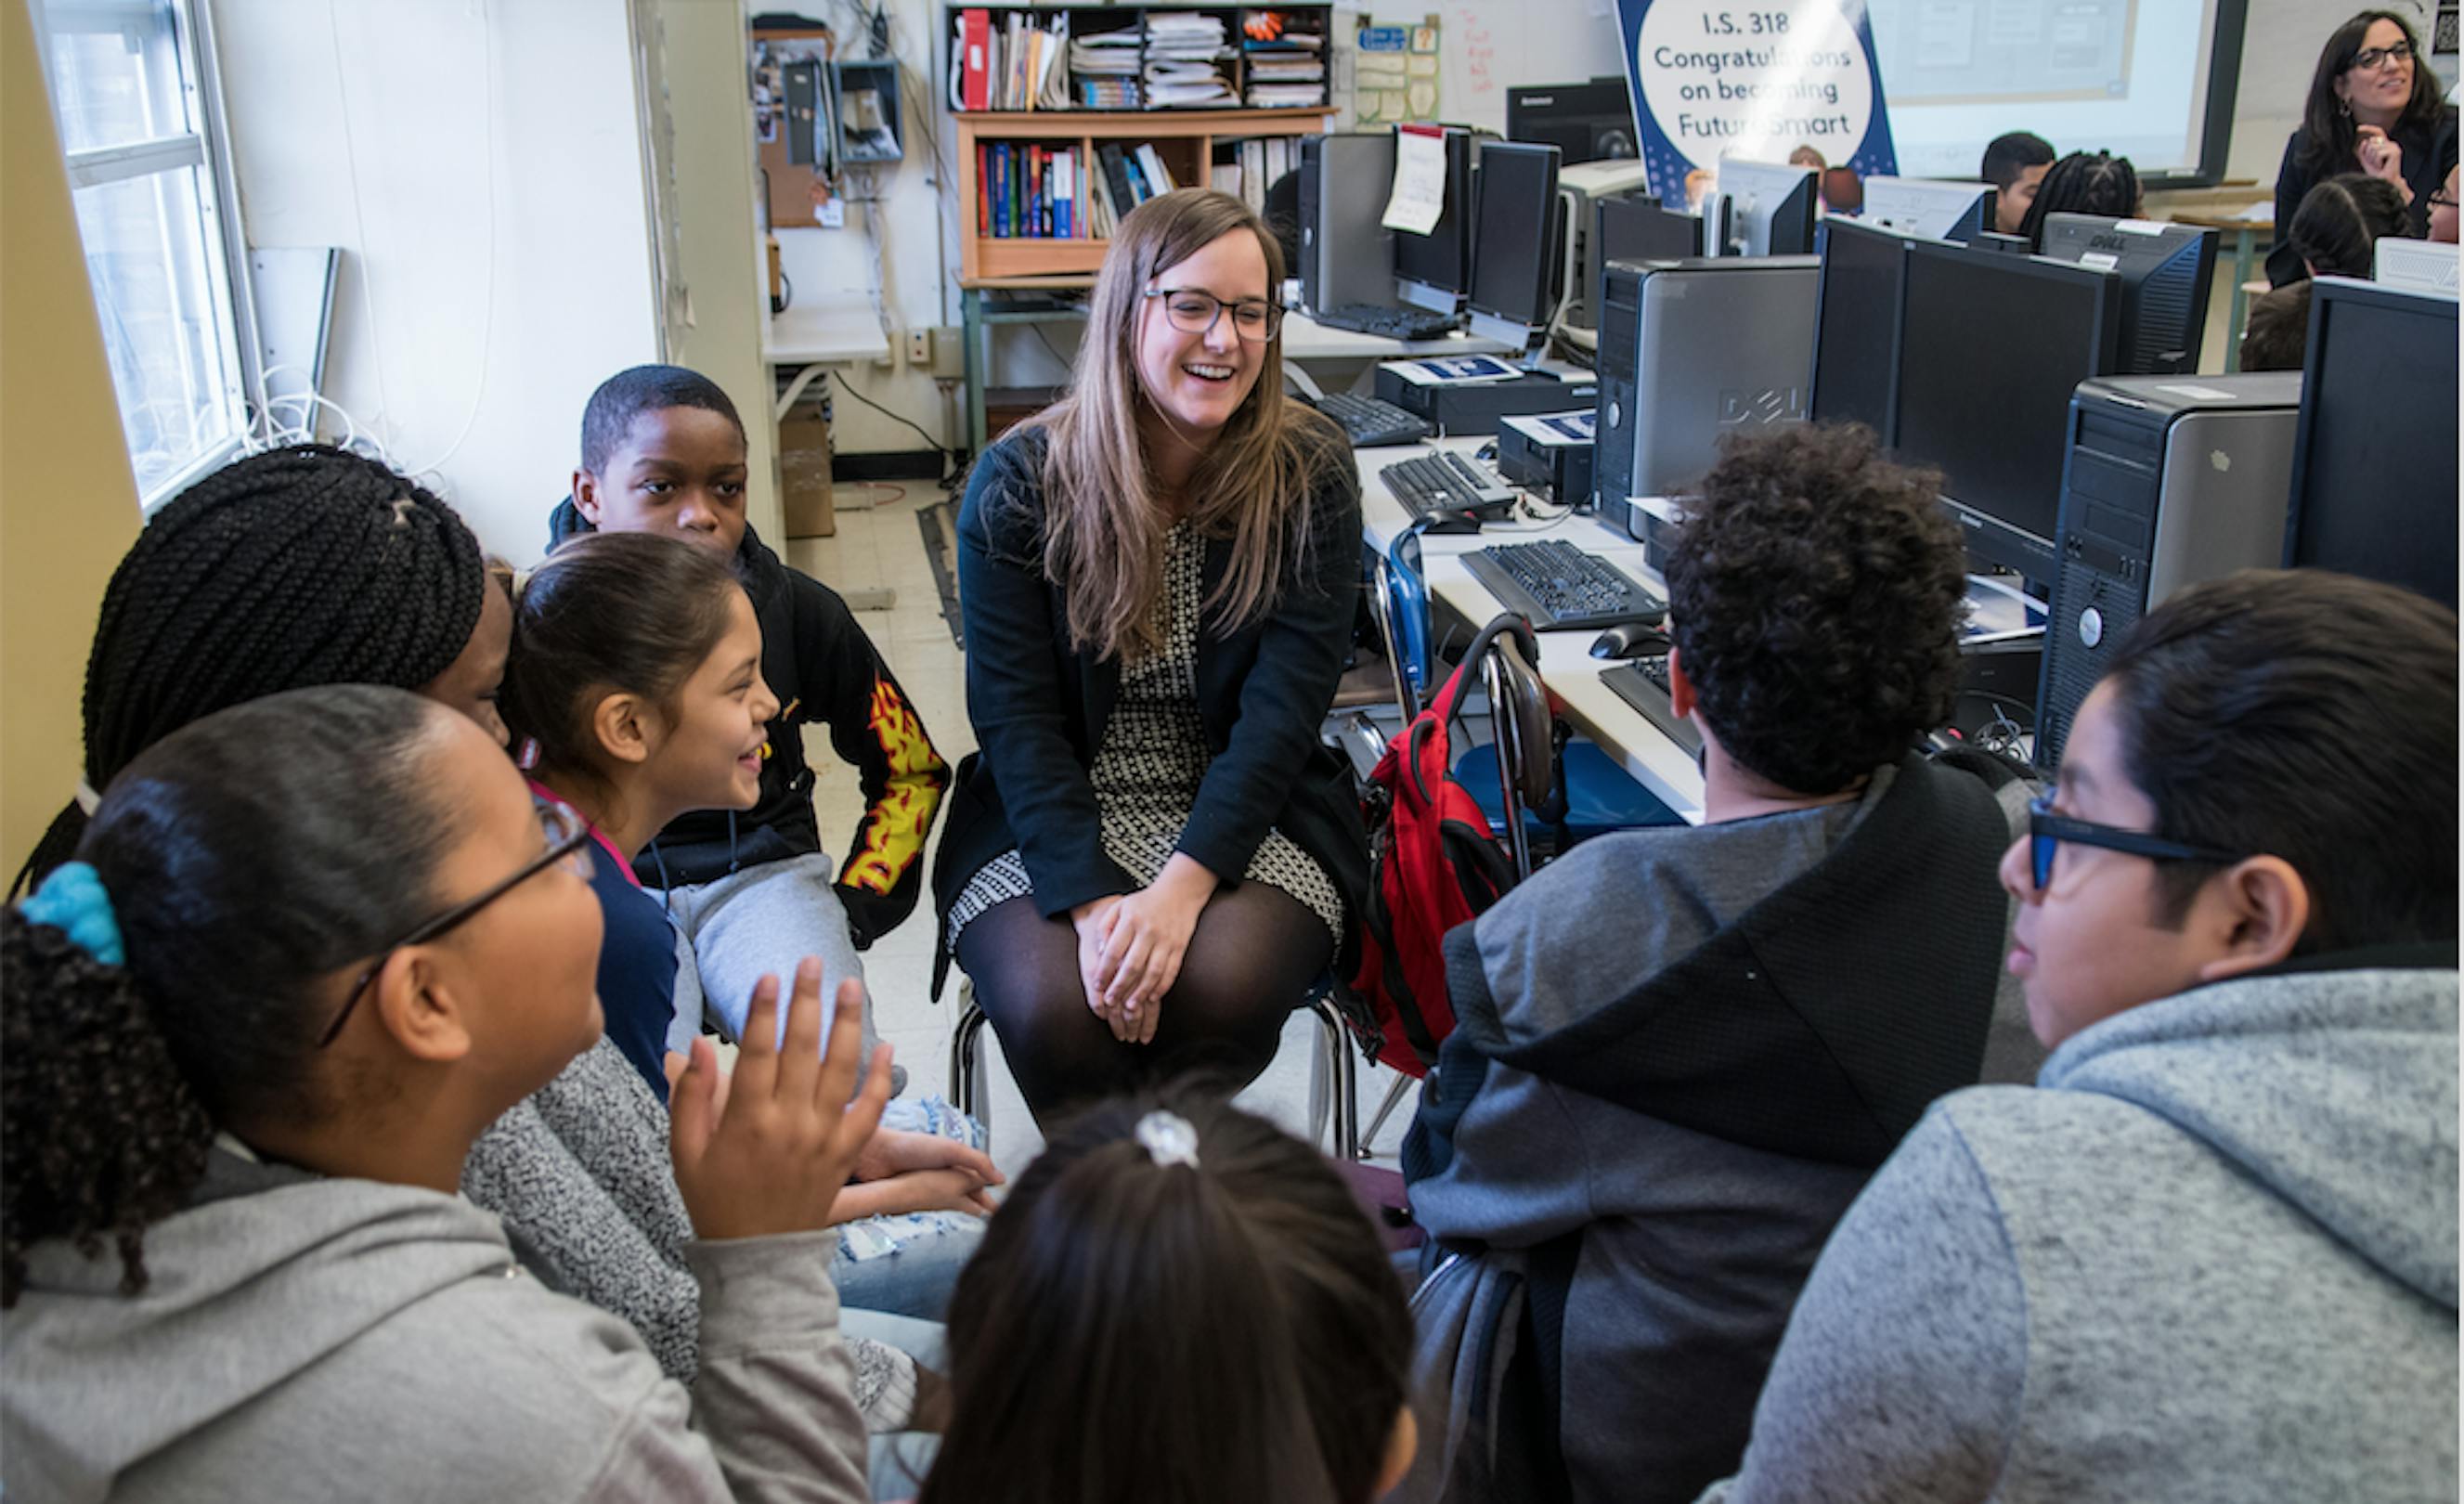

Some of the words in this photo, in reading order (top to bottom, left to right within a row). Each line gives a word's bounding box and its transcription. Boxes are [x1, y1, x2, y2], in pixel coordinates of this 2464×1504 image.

[1703, 12, 1743, 35] I.S.
[1750, 11, 1790, 35] 318
[1654, 45, 1851, 74] Congratulons
[1679, 84, 1710, 100] on
[1718, 77, 1838, 104] becming
[1718, 386, 1807, 424] DEL
